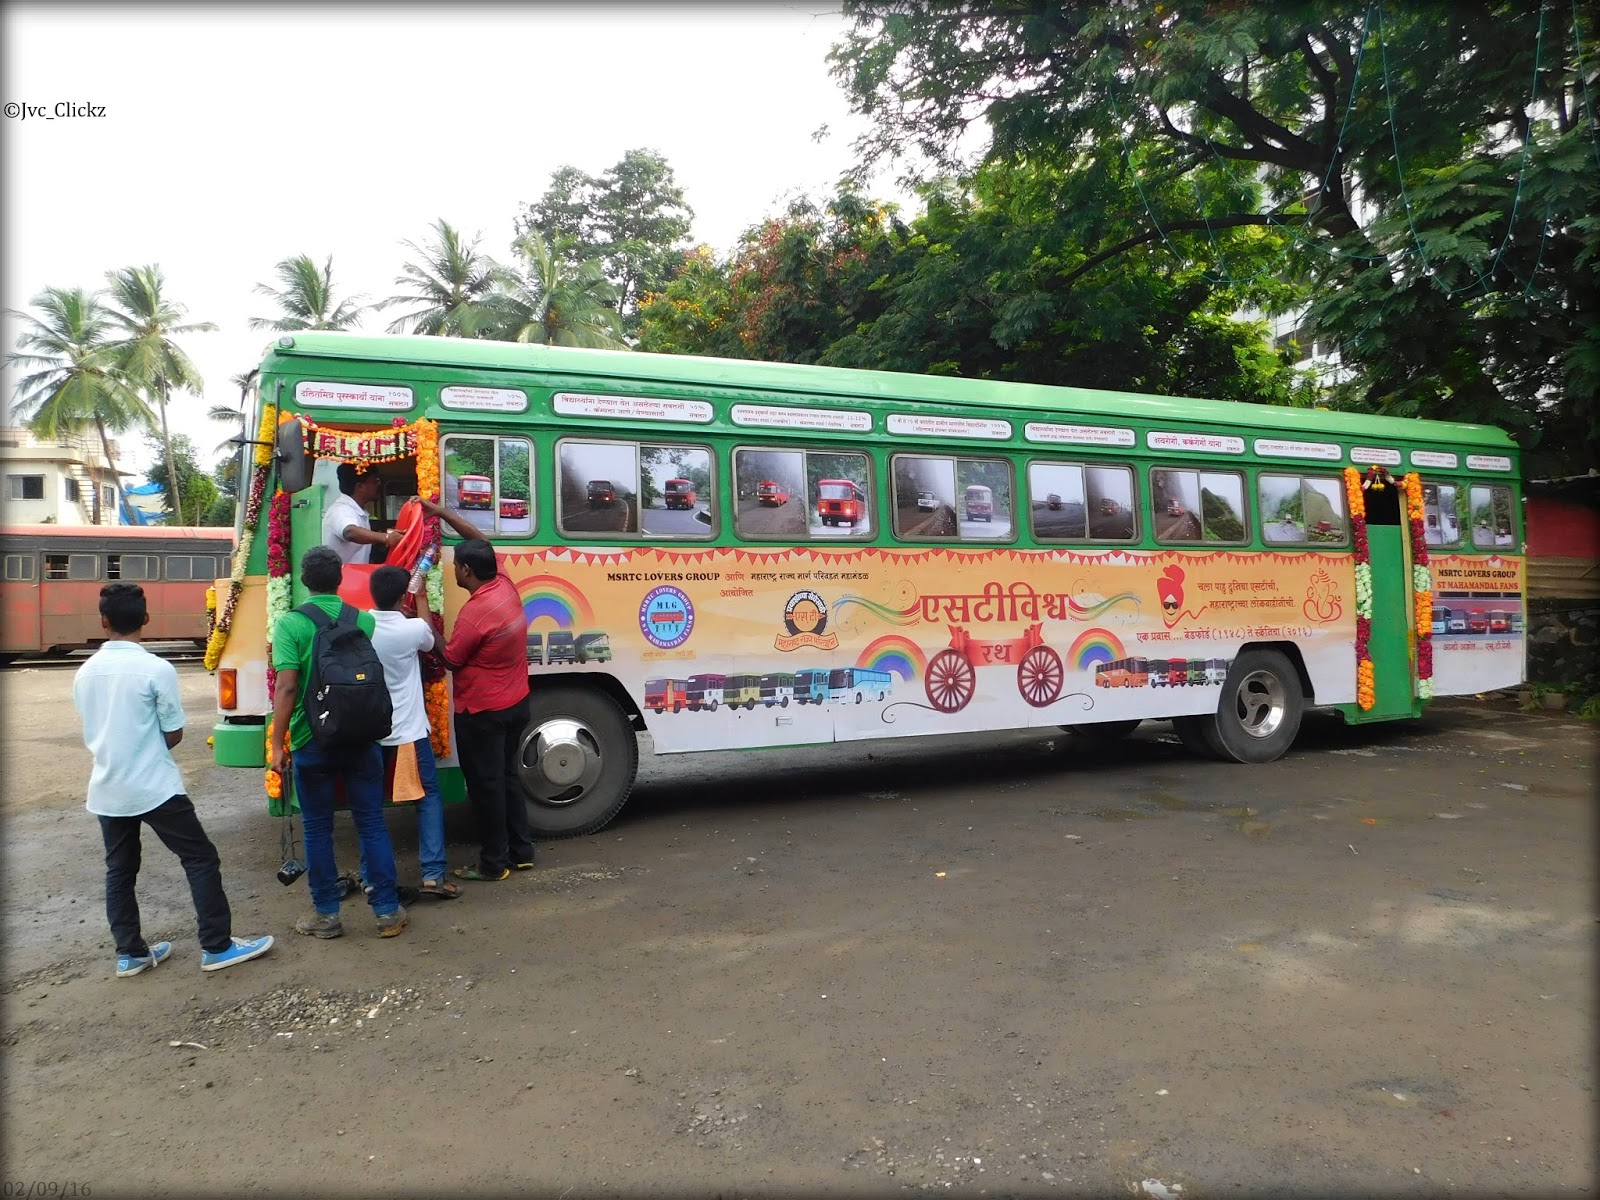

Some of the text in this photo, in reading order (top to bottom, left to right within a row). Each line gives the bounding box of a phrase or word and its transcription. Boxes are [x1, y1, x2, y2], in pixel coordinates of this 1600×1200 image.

[607, 573, 642, 581] MSRTC
[644, 573, 683, 581] LOVERS
[725, 571, 745, 581] आणि
[750, 572, 777, 582] महाराष्ट्र
[780, 572, 795, 580] राज्य
[813, 570, 838, 580] परिवहन
[841, 571, 869, 580] महामंडळ
[1438, 569, 1462, 577] MSRTC
[1197, 583, 1212, 591] चला
[920, 582, 1069, 623] एसटीविश्व
[1136, 632, 1149, 643] एक
[1151, 632, 1171, 640] प्रवास
[980, 644, 1012, 663] रथ
